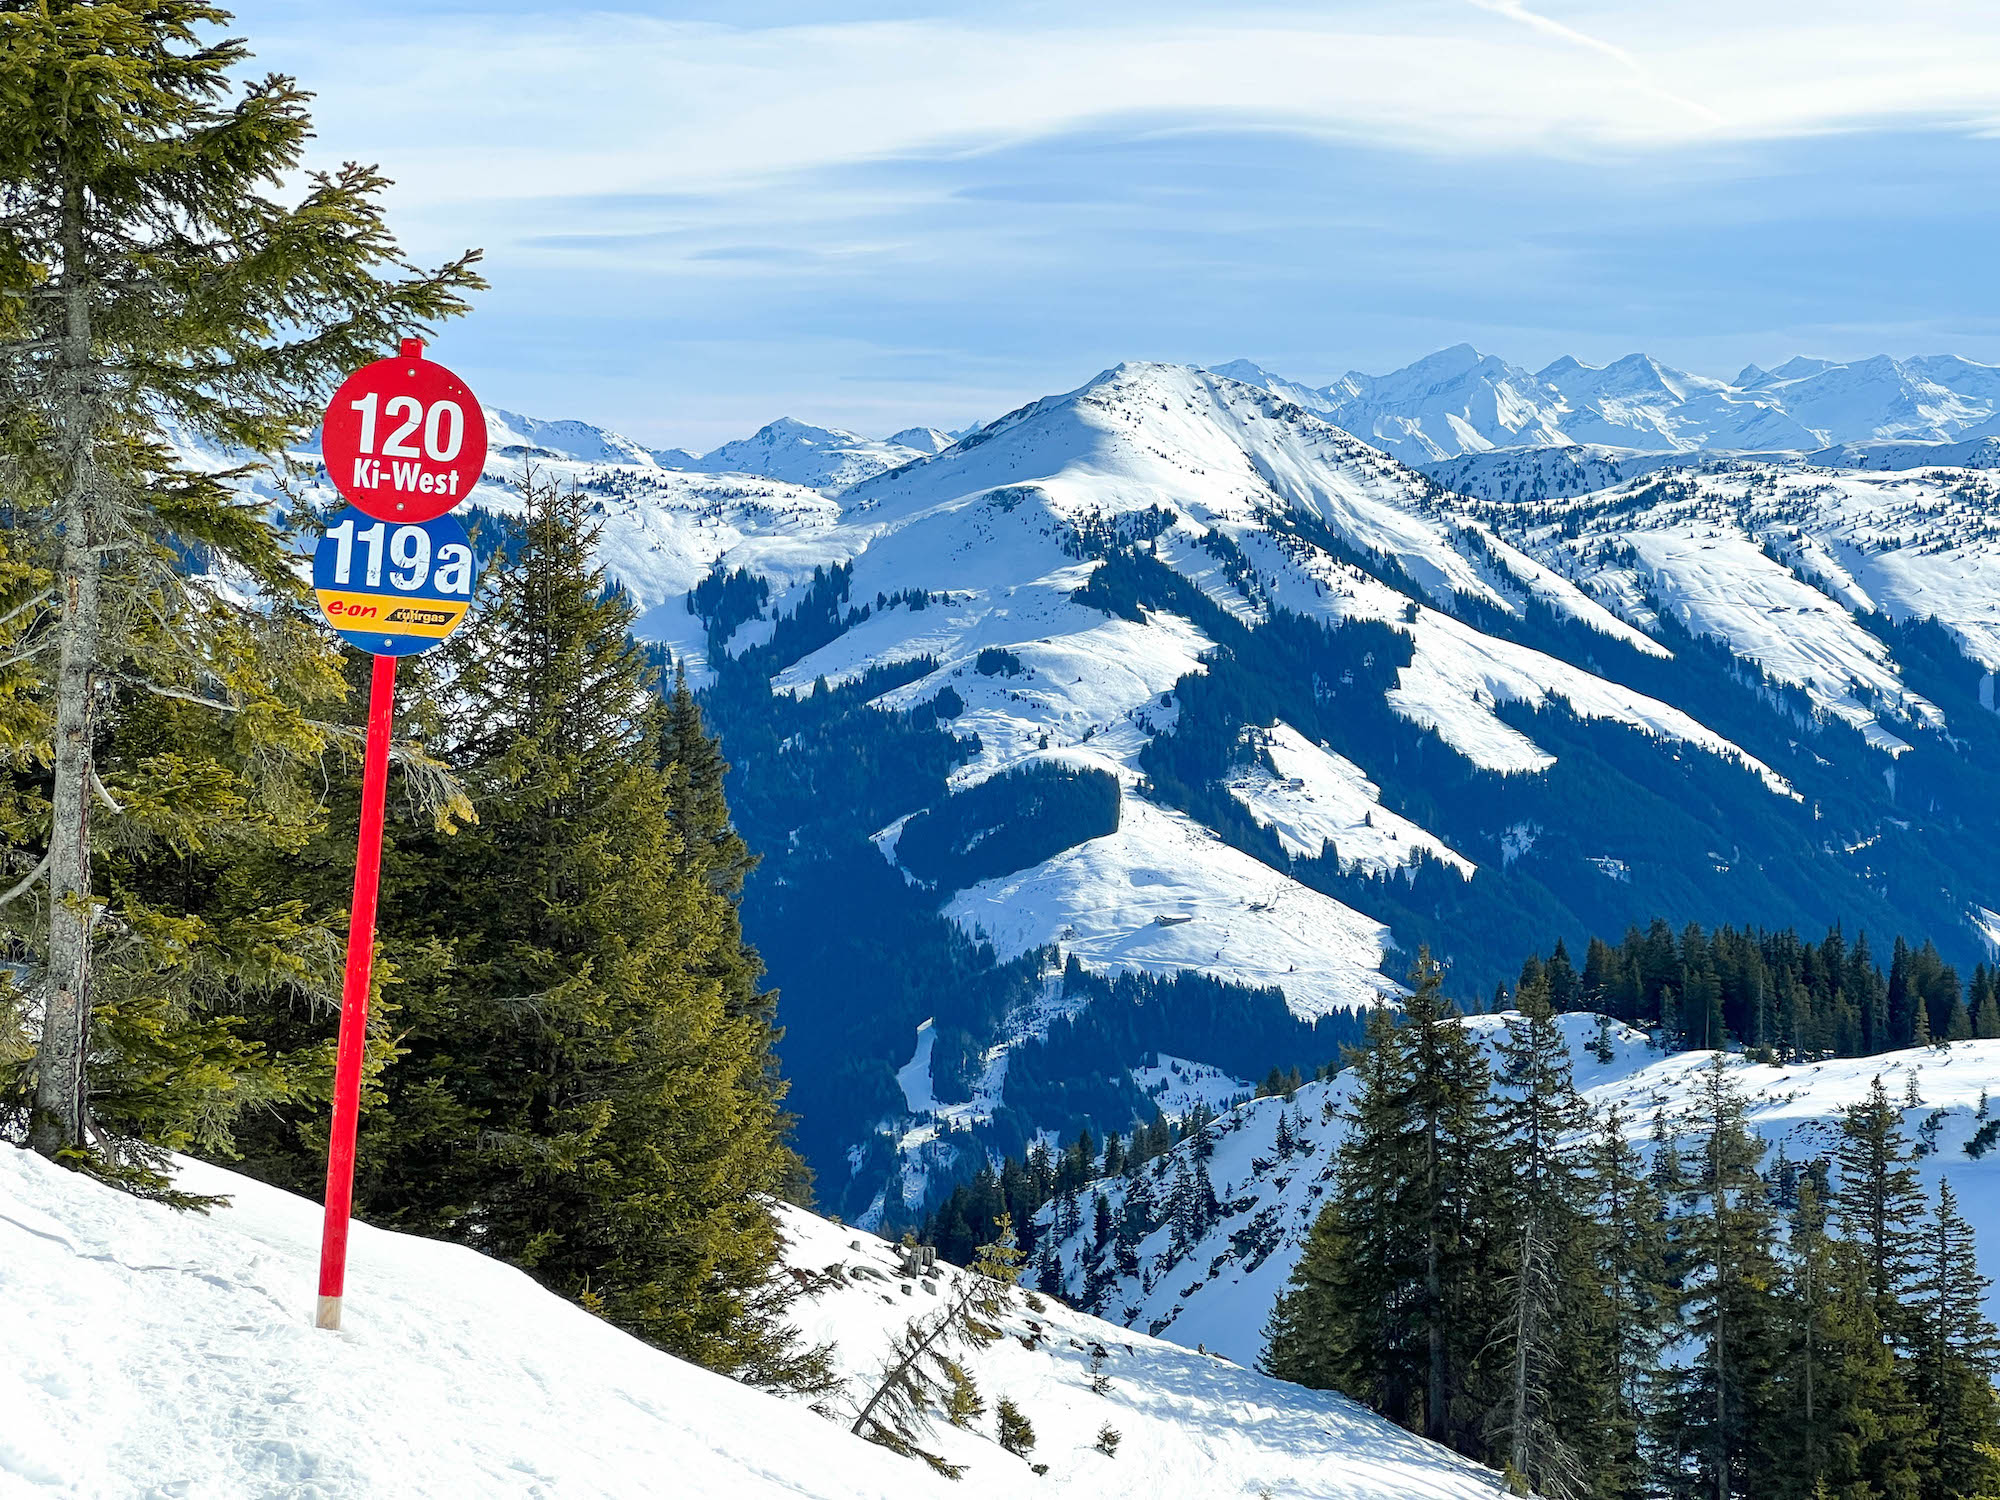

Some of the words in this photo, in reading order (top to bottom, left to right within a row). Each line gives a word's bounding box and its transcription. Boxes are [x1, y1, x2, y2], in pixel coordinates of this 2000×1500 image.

[351, 392, 464, 462] 120
[353, 458, 460, 495] Ki-West
[326, 519, 473, 595] 119a
[396, 610, 446, 624] ruhrgas
